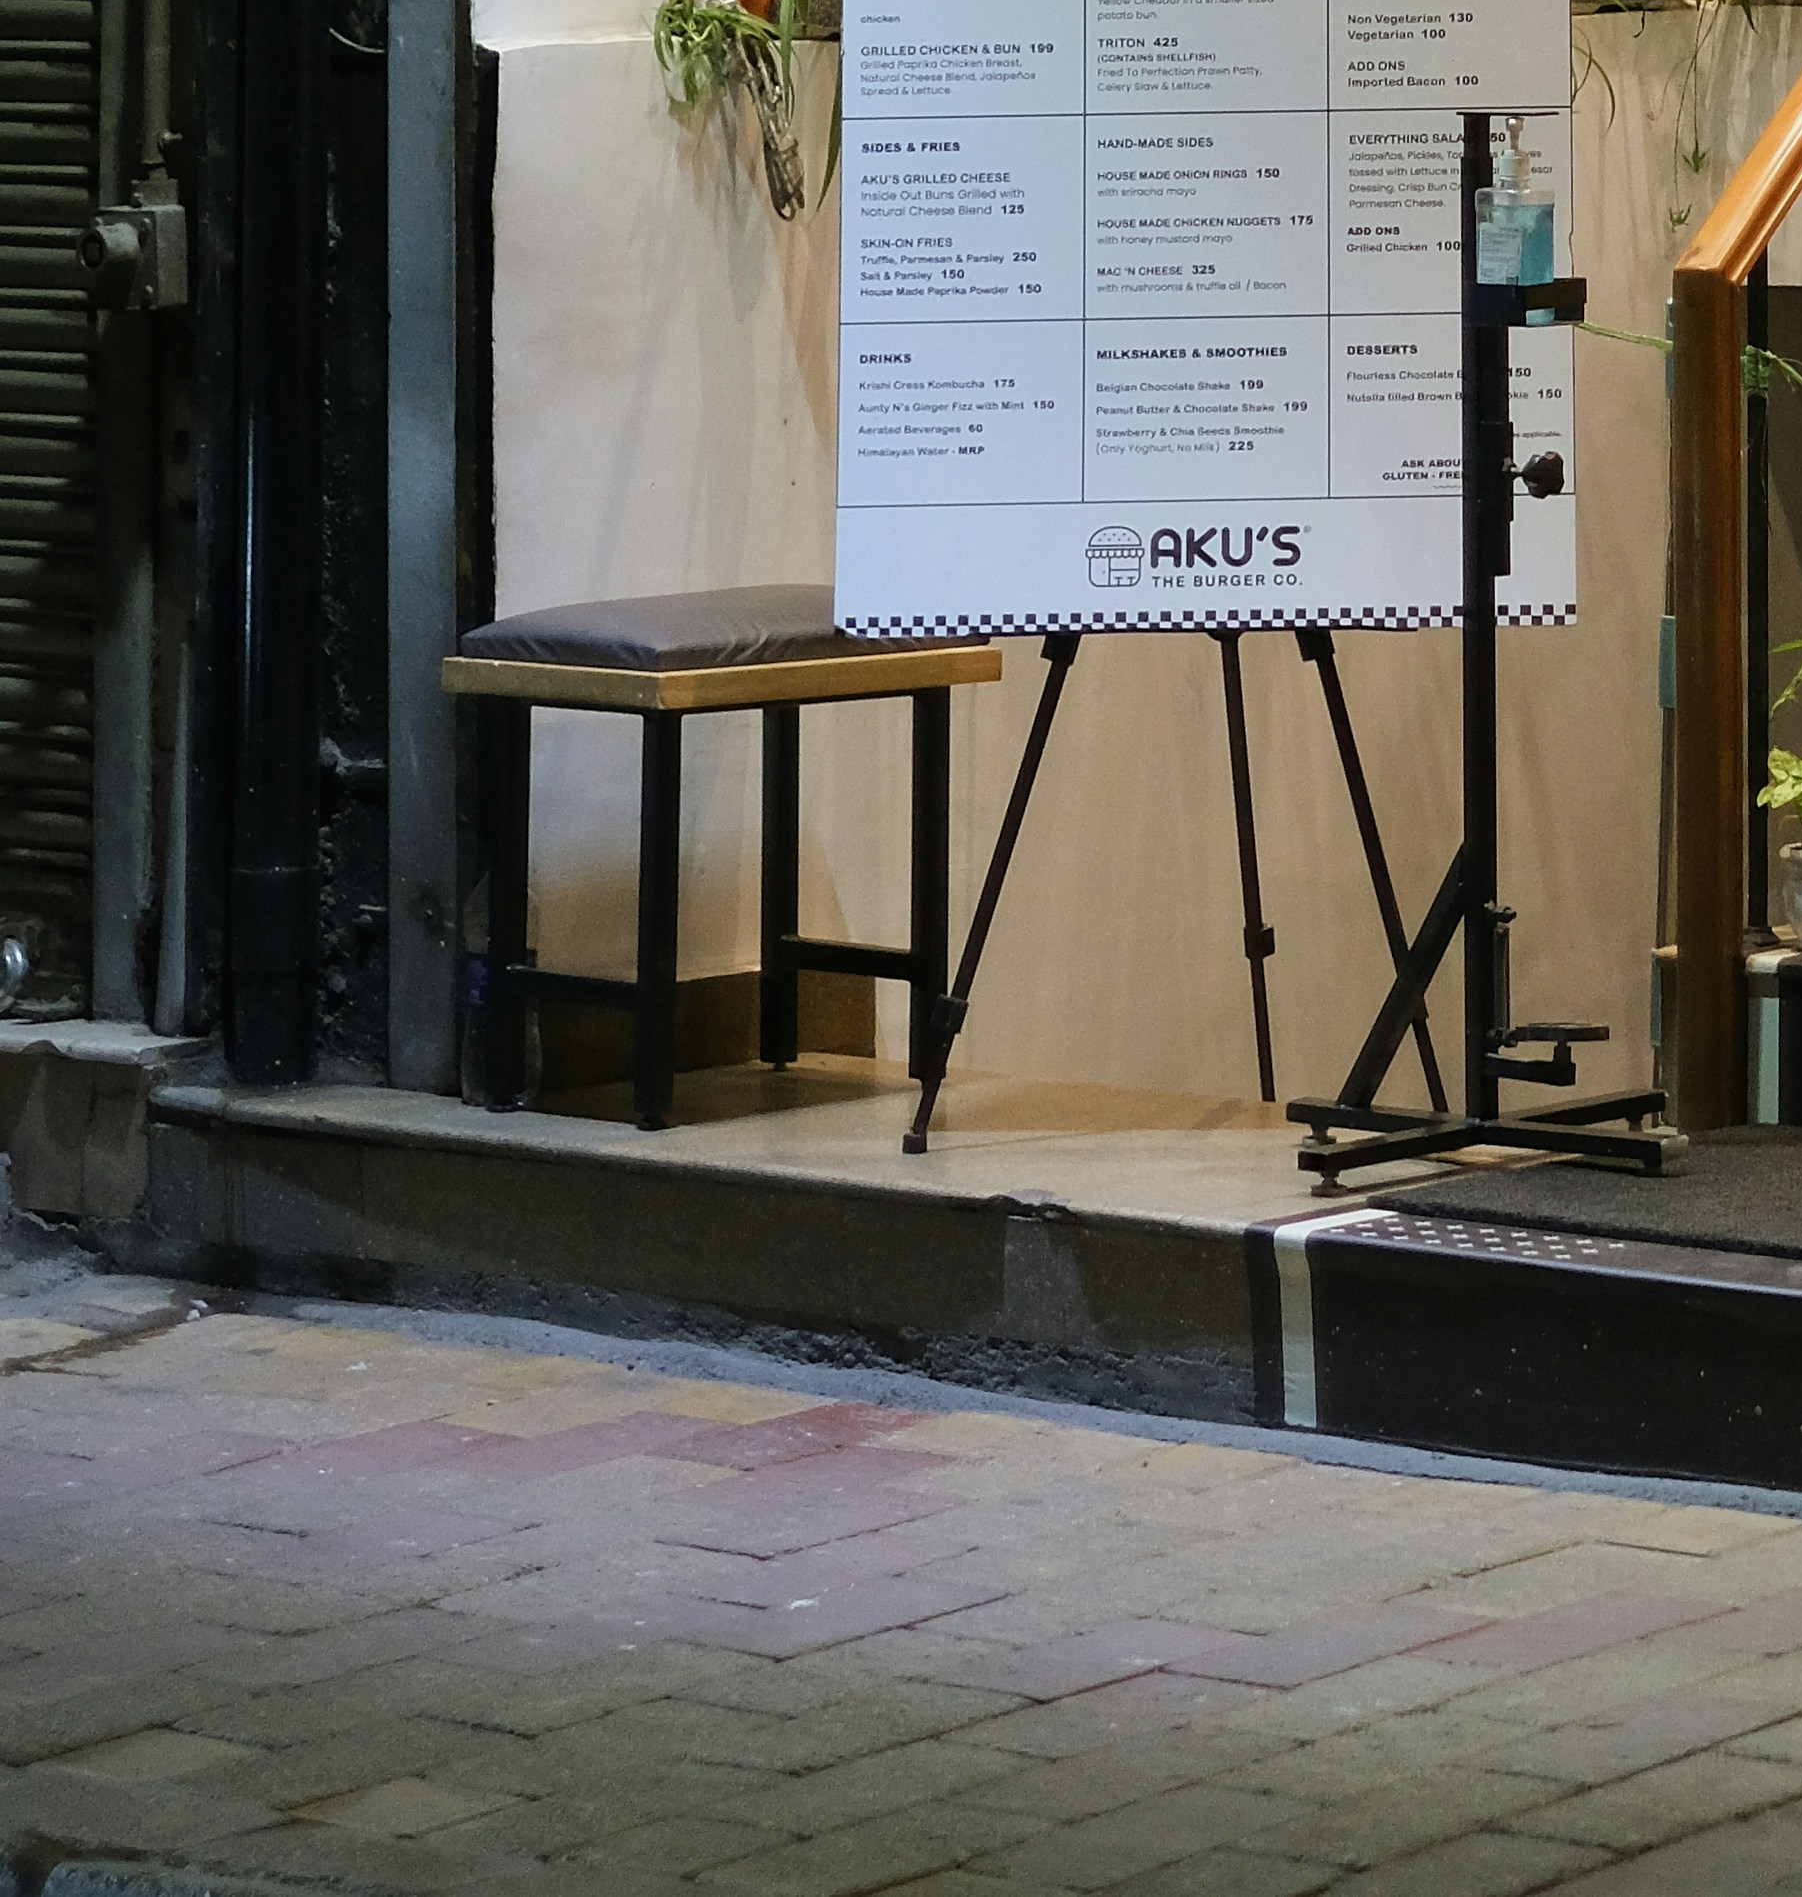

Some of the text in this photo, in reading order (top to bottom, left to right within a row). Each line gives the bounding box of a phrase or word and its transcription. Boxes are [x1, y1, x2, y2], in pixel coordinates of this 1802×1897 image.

[1347, 11, 1473, 26] Non Vegetarian 130
[1346, 28, 1446, 42] Vegetarian 100
[1096, 36, 1178, 48] TRITON 425
[860, 42, 1054, 57] GRILLED CHICKEN & BUN 199
[1346, 59, 1405, 72] ADD ONS
[1347, 74, 1479, 88] Imported Bacon 100
[1096, 136, 1214, 149] HAND-MADE SIDES
[1348, 132, 1465, 145] EVERYTHING SALA
[860, 141, 960, 153] SIDES & FRIES
[860, 171, 1011, 185] AKU'S GRILLED CHEESE
[1096, 167, 1280, 181] HOUSE MADE ONION RINGS 150
[1096, 214, 1313, 229] HOUSE MADE CHICKEN NUGGETS 175
[1346, 225, 1400, 236] ADD ONS
[860, 236, 953, 249] SKIN-ON FRIES
[1435, 240, 1462, 251] 100
[1137, 265, 1183, 276] CHEESE
[1191, 263, 1216, 275] 325
[1096, 346, 1287, 360] MILKSHAKES & SMOOTHIES
[1346, 343, 1418, 356] DESSERTS
[858, 352, 912, 364] DRINKS
[1400, 459, 1425, 468] ASK
[1381, 470, 1428, 481] GLUTEN
[1150, 526, 1301, 569] AKU'S
[1150, 572, 1302, 588] THE BURGER CO.
